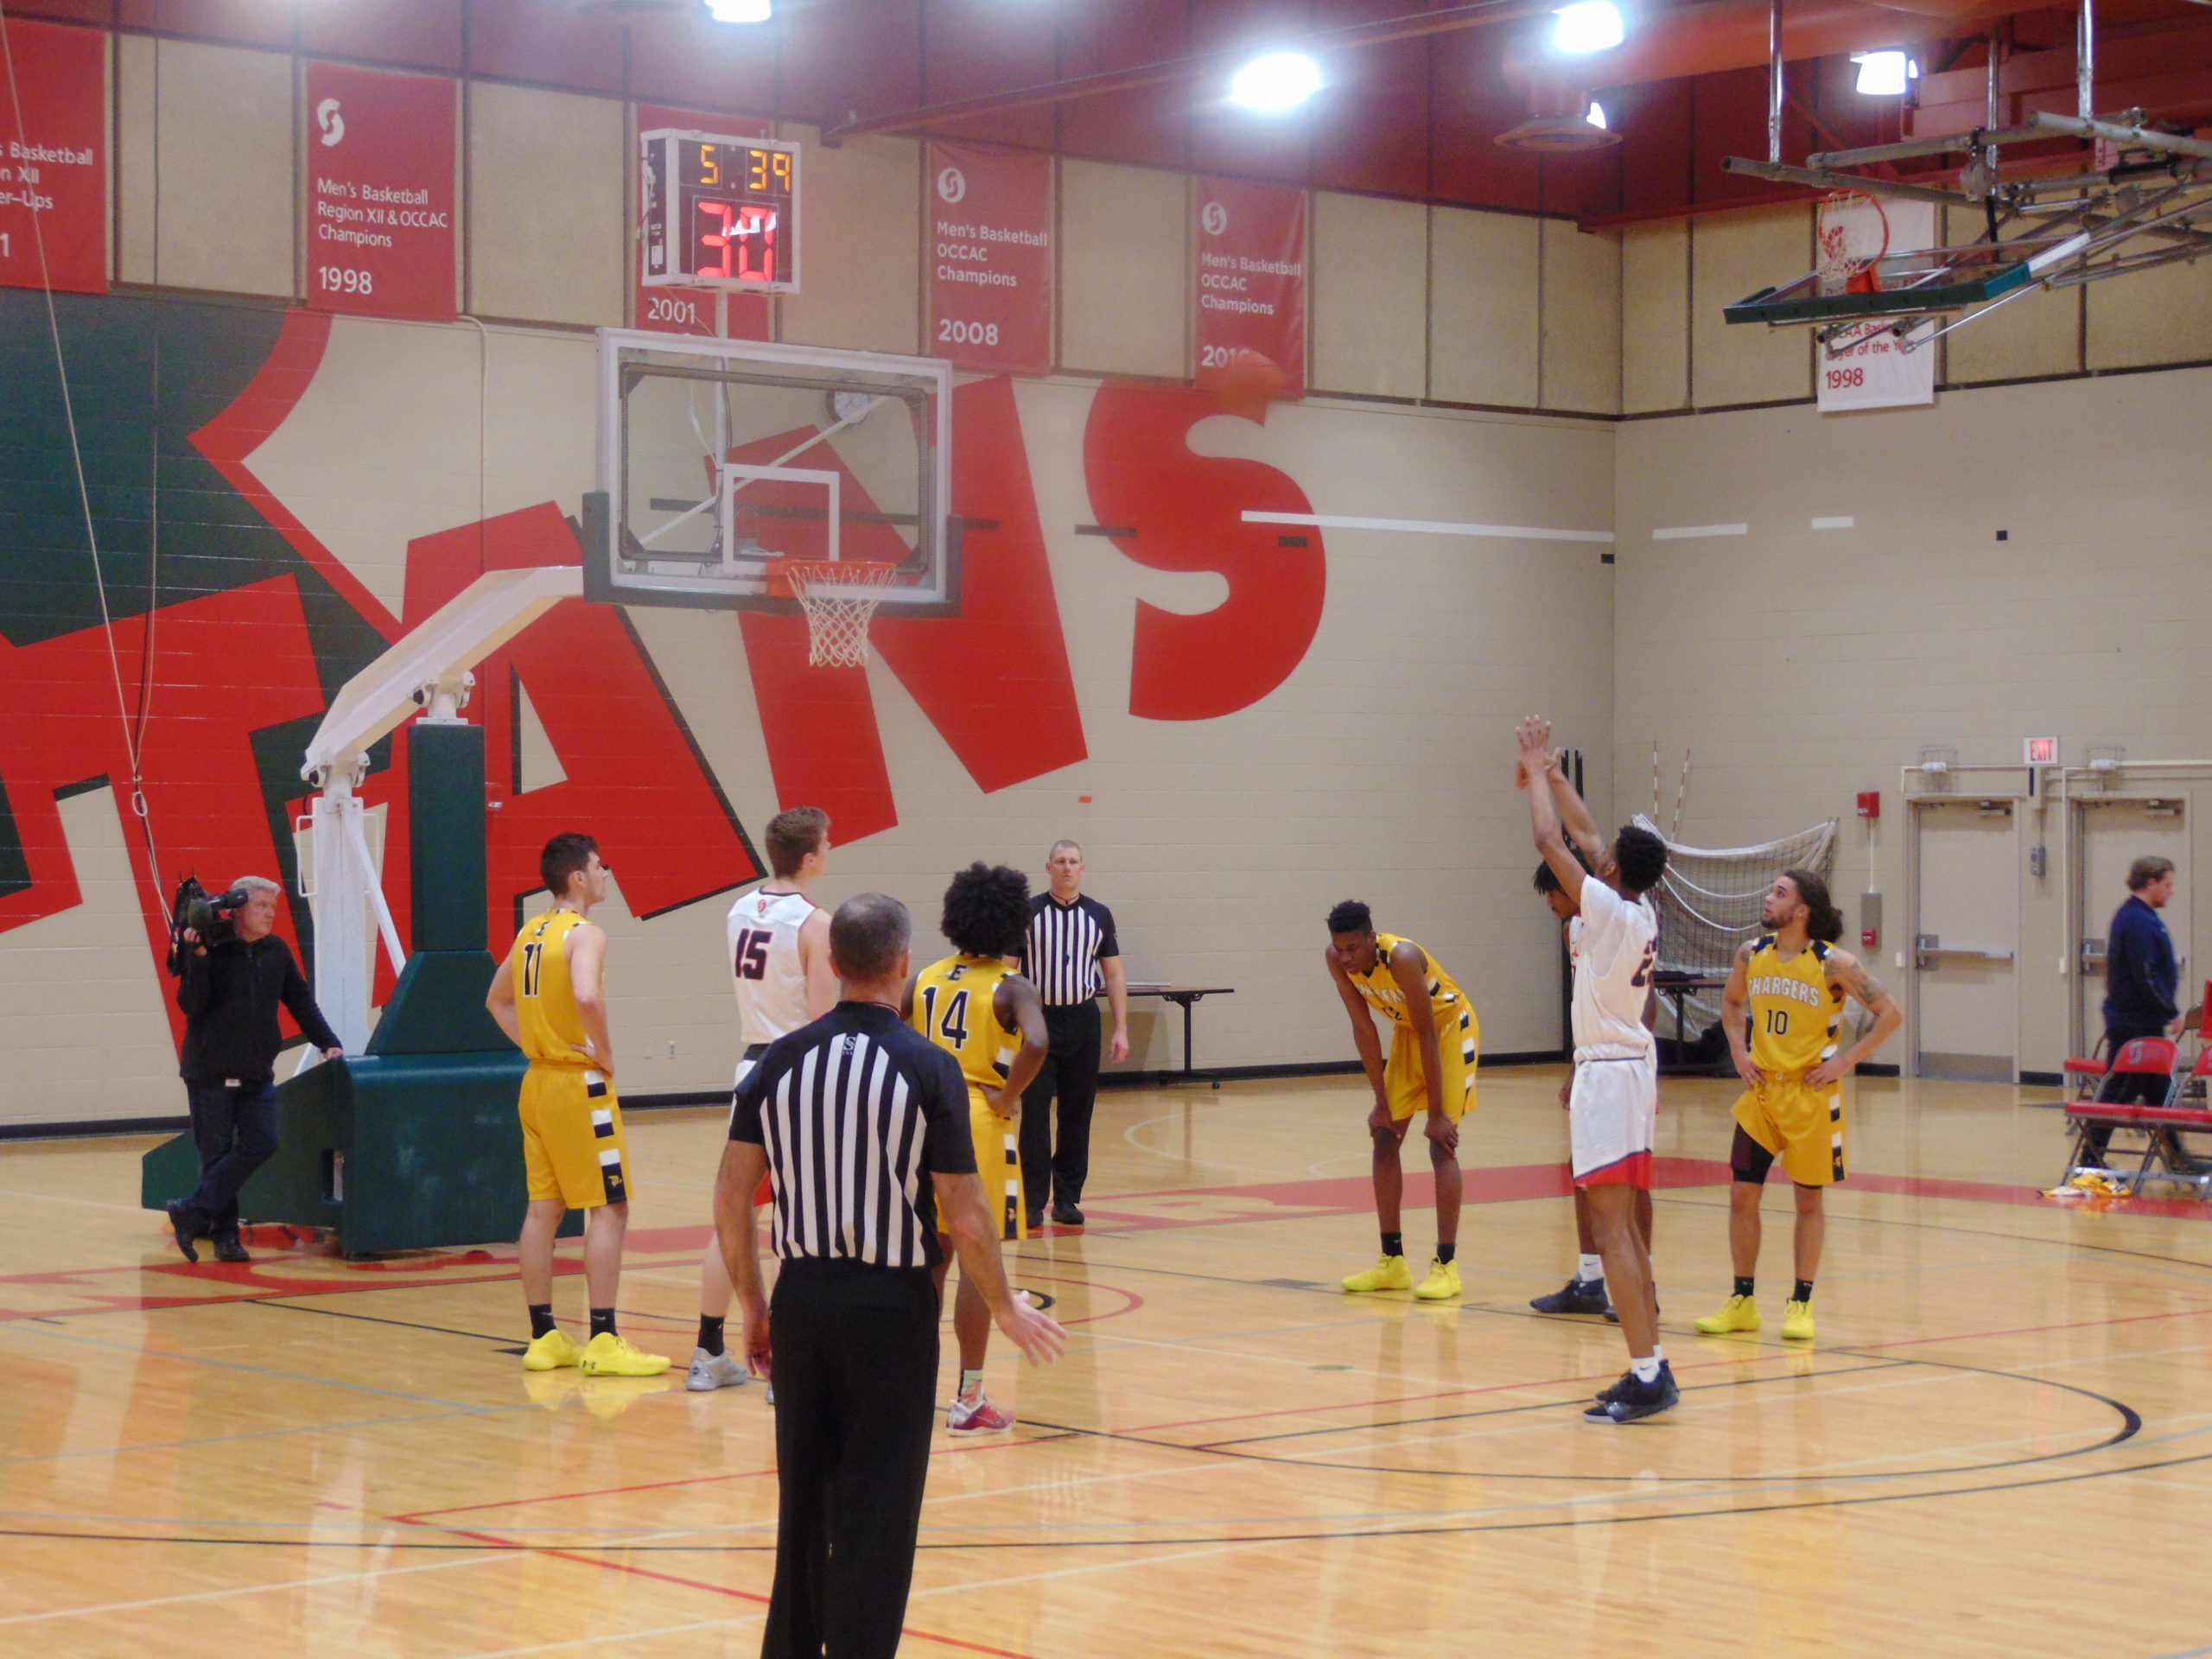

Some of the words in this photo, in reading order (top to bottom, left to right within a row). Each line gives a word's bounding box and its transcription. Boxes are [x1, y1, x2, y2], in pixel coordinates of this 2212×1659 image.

[10, 142, 92, 166] Basketball
[17, 166, 39, 184] XII
[701, 144, 719, 184] 5
[748, 150, 791, 192] 39
[0, 191, 54, 212] er-Ups
[318, 178, 356, 199] Men's
[362, 184, 429, 205] Basketball
[318, 201, 364, 223] Region
[367, 208, 384, 224] XII
[388, 212, 398, 226] &
[400, 213, 448, 228] OCCAC
[319, 225, 392, 248] Champions
[938, 221, 976, 238] Men's
[980, 226, 1047, 246] Basketball
[938, 243, 988, 261] OCCAC
[938, 265, 1018, 287] Champions
[1202, 253, 1236, 270] Men's
[1240, 257, 1301, 276] Basketball
[319, 266, 372, 295] 1998
[1202, 273, 1248, 291] OCCAC
[648, 297, 695, 324] 2001
[1202, 295, 1274, 315] Champions
[938, 319, 999, 346] 2008
[1858, 341, 1870, 355] of
[1872, 342, 1890, 354] the
[1826, 367, 1864, 389] 1998
[2030, 740, 2053, 761] EXIT
[734, 928, 773, 981] 15
[524, 942, 544, 996] 11
[922, 985, 970, 1051] 14
[1766, 1009, 1788, 1035] 10
